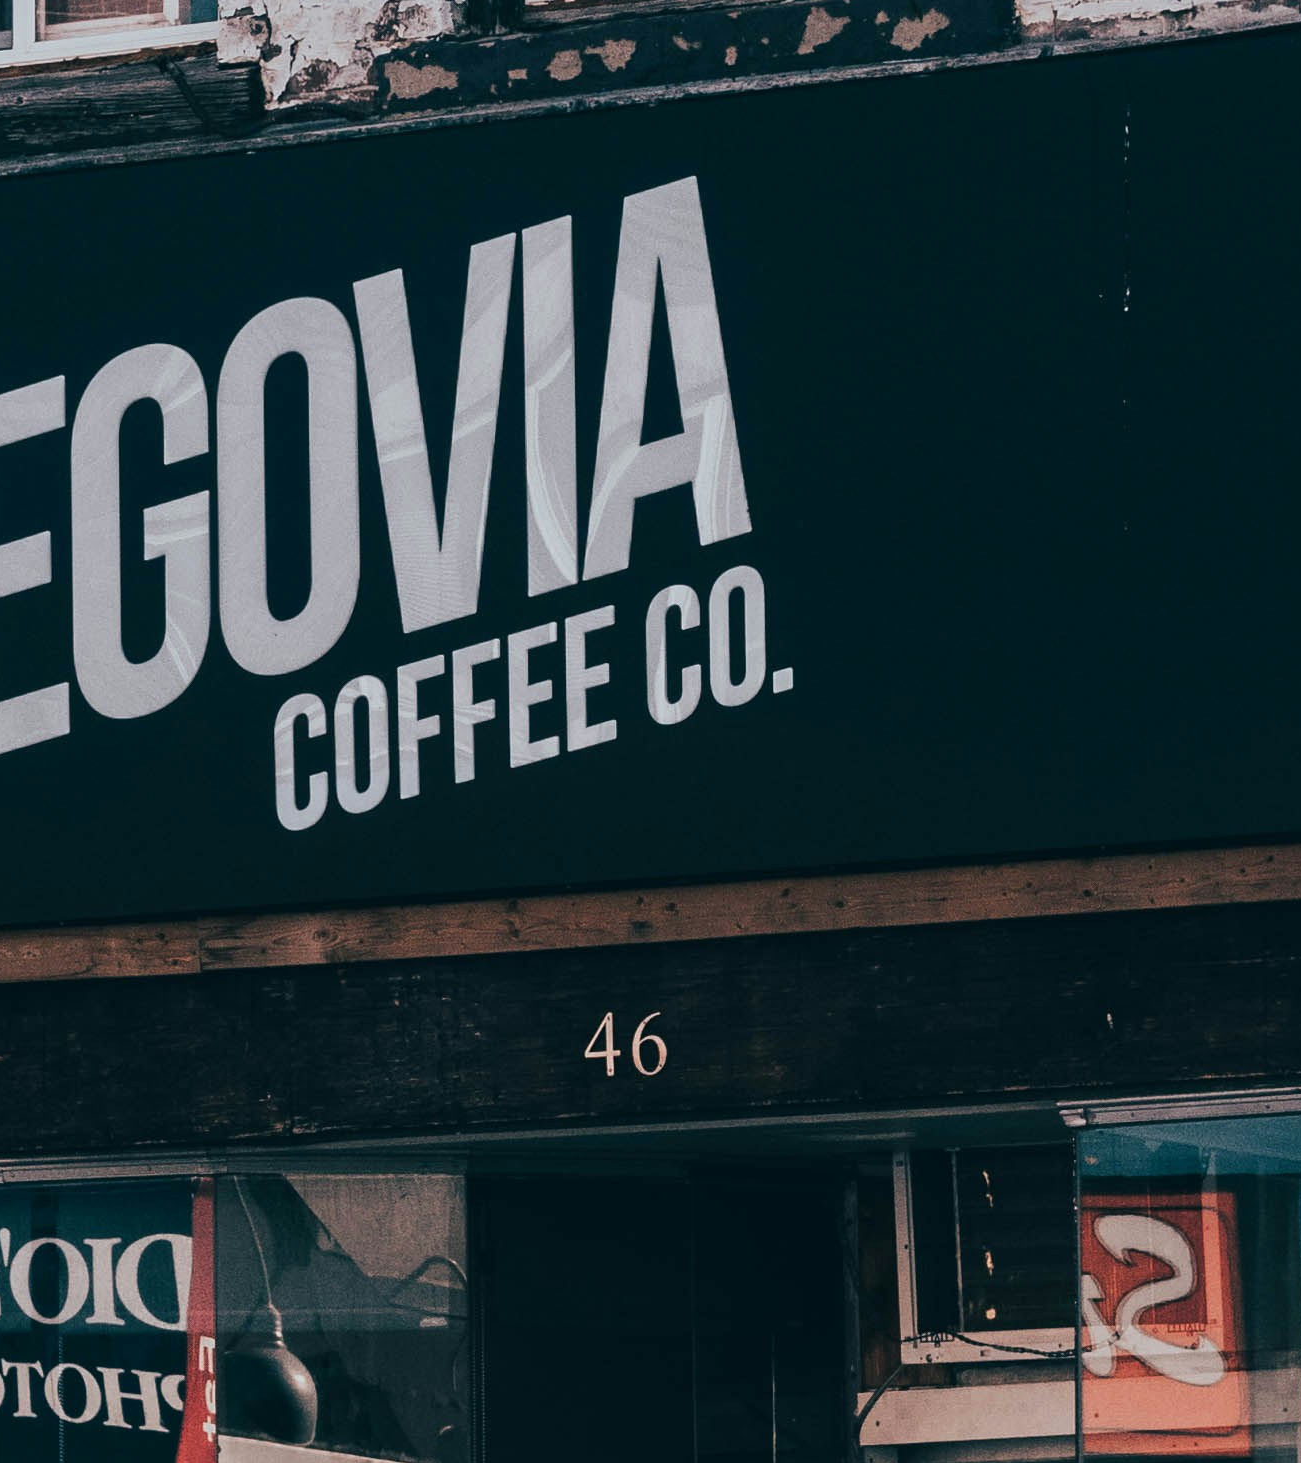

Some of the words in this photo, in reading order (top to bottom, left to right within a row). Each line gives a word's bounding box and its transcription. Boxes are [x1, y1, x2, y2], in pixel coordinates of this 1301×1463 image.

[273, 603, 617, 832] COFFEE
[645, 564, 795, 726] CO.
[584, 1011, 669, 1077] 46
